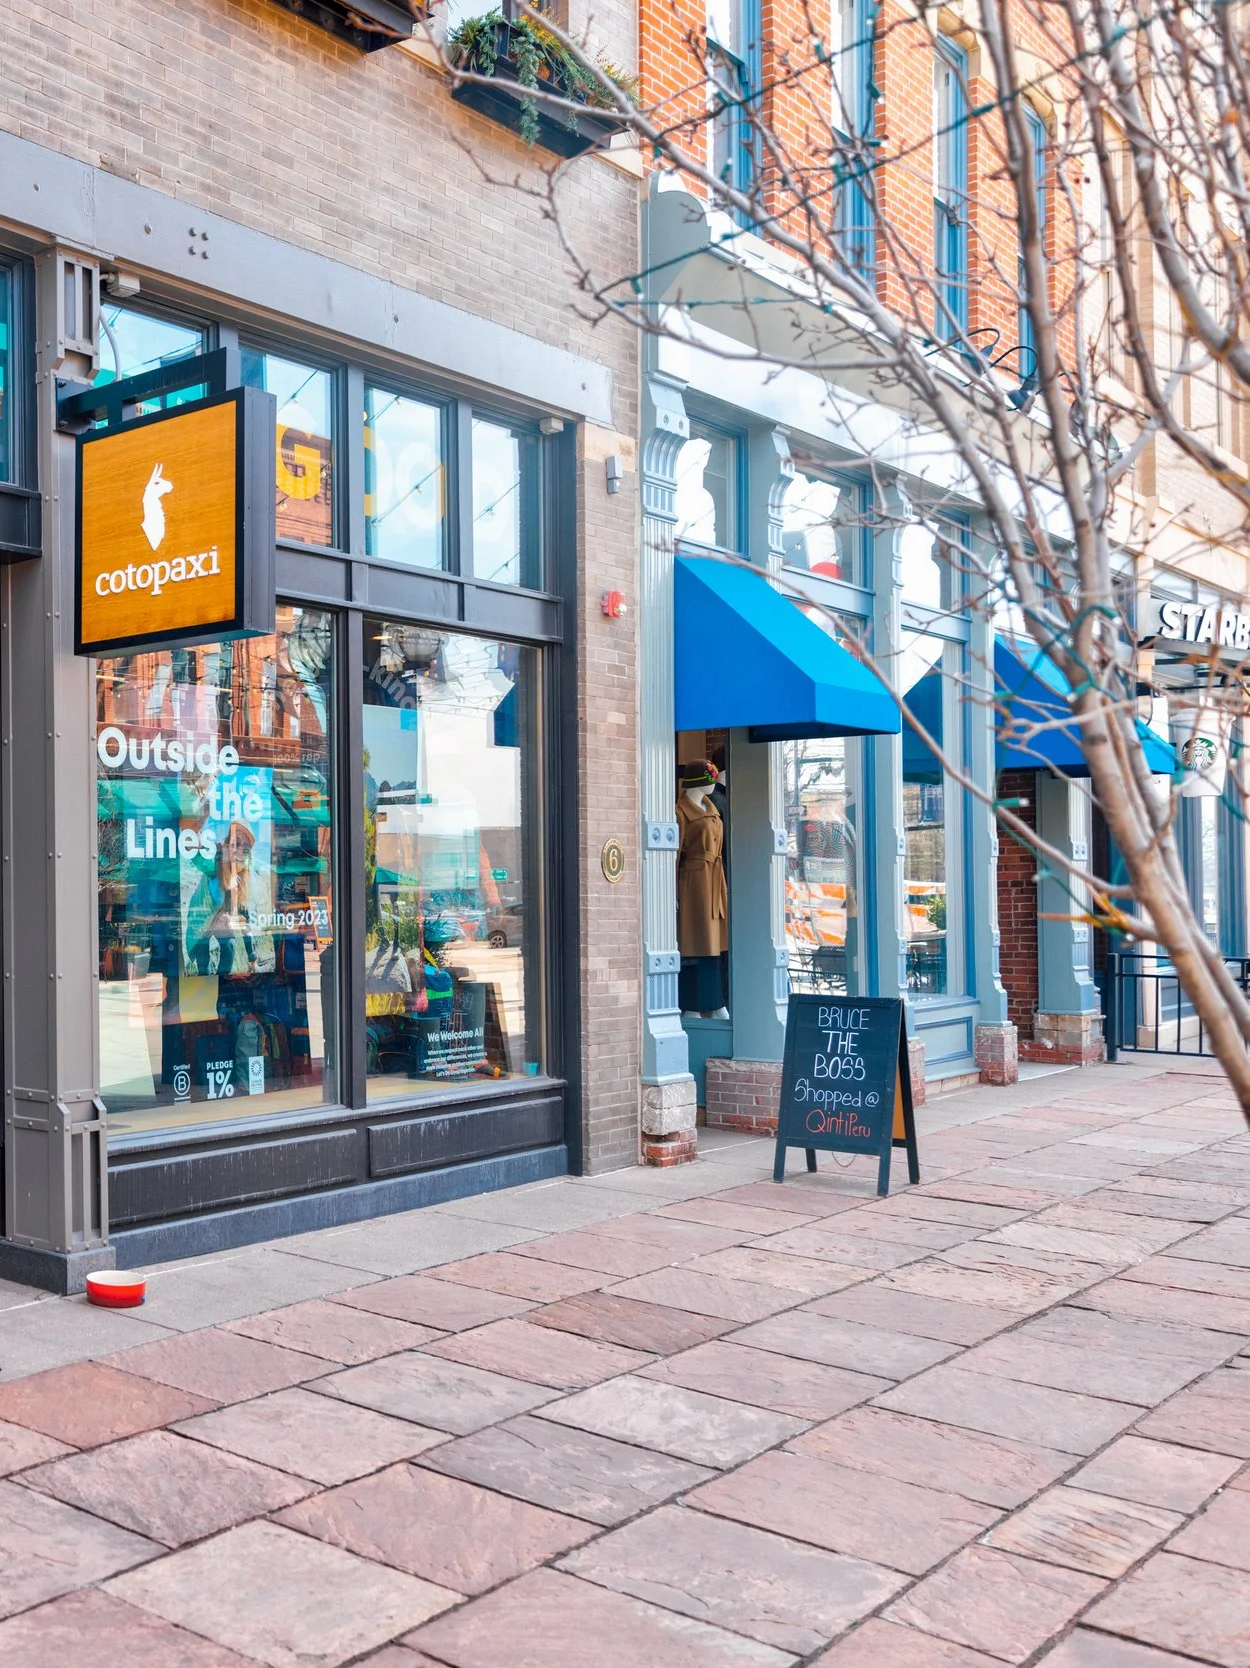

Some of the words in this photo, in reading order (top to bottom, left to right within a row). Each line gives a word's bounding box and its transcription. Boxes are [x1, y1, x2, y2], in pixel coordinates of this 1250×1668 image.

[95, 545, 220, 596] cotopaxi
[97, 726, 240, 775] Outside
[209, 776, 264, 822] the
[125, 817, 218, 860] Lines
[610, 848, 618, 871] 6
[249, 908, 295, 930] Spring
[298, 909, 329, 925] 2023
[817, 1006, 871, 1030] BRUCE
[427, 1032, 440, 1042] We
[440, 1029, 473, 1041] Welcome
[474, 1026, 484, 1037] All
[821, 1030, 860, 1056] THE
[206, 1060, 234, 1071] PLEDGE
[813, 1053, 866, 1081] BOSS
[206, 1070, 235, 1100] 1%
[794, 1078, 861, 1112] Shopped
[864, 1091, 880, 1108] @
